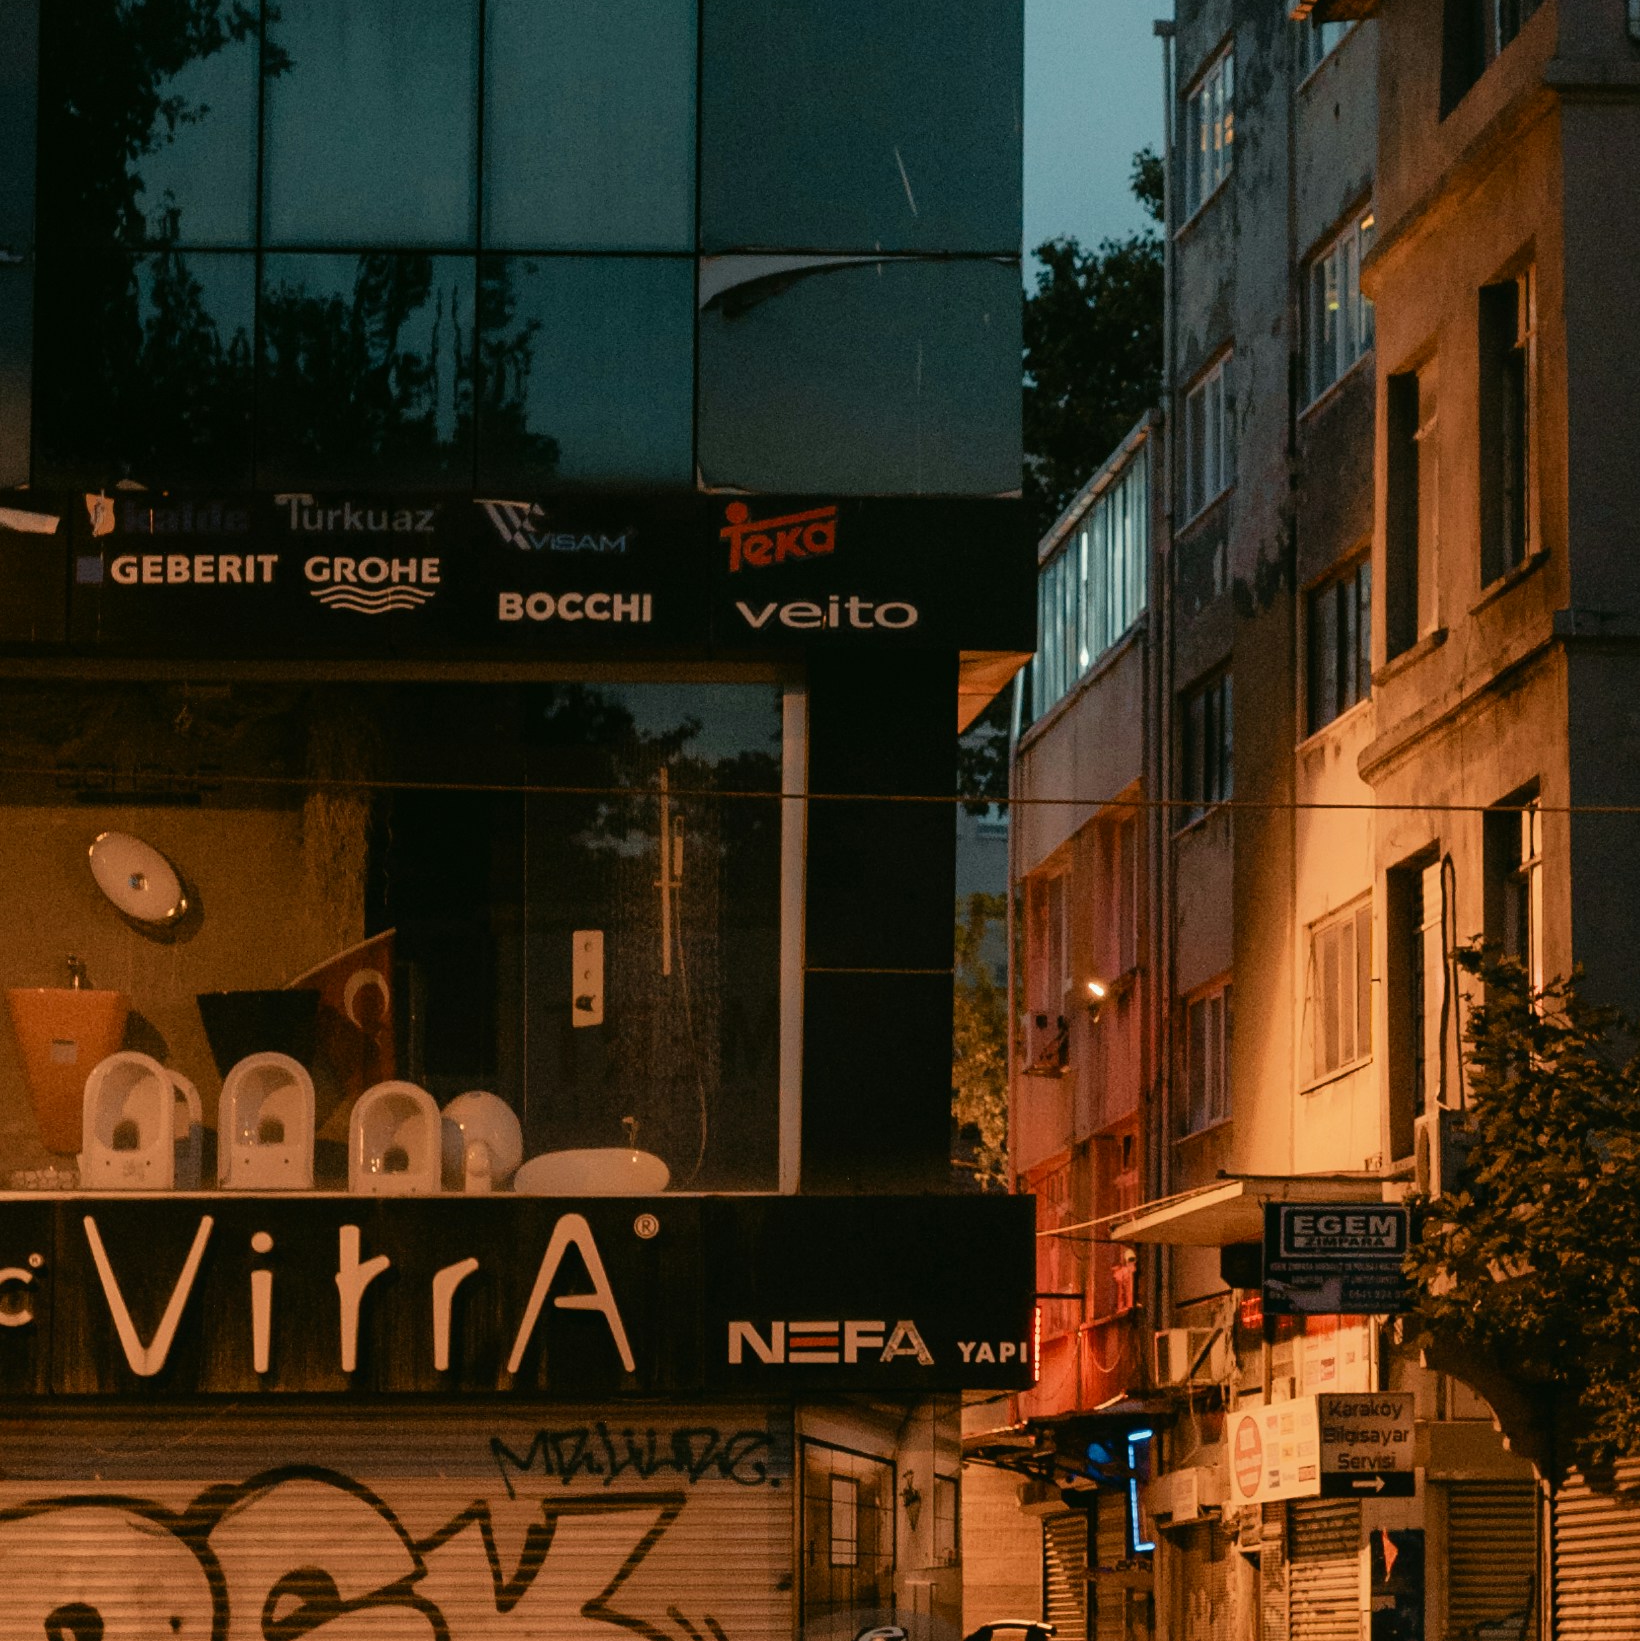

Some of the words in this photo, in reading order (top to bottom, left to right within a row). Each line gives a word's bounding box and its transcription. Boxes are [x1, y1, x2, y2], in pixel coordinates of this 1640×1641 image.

[110, 554, 279, 584] GEBERIT
[303, 556, 441, 583] GROHE
[498, 591, 653, 623] BOCCHI
[734, 594, 919, 630] veito
[1293, 1215, 1398, 1236] EGEM
[727, 1319, 935, 1366] NEFA
[956, 1341, 1028, 1364] YAPI
